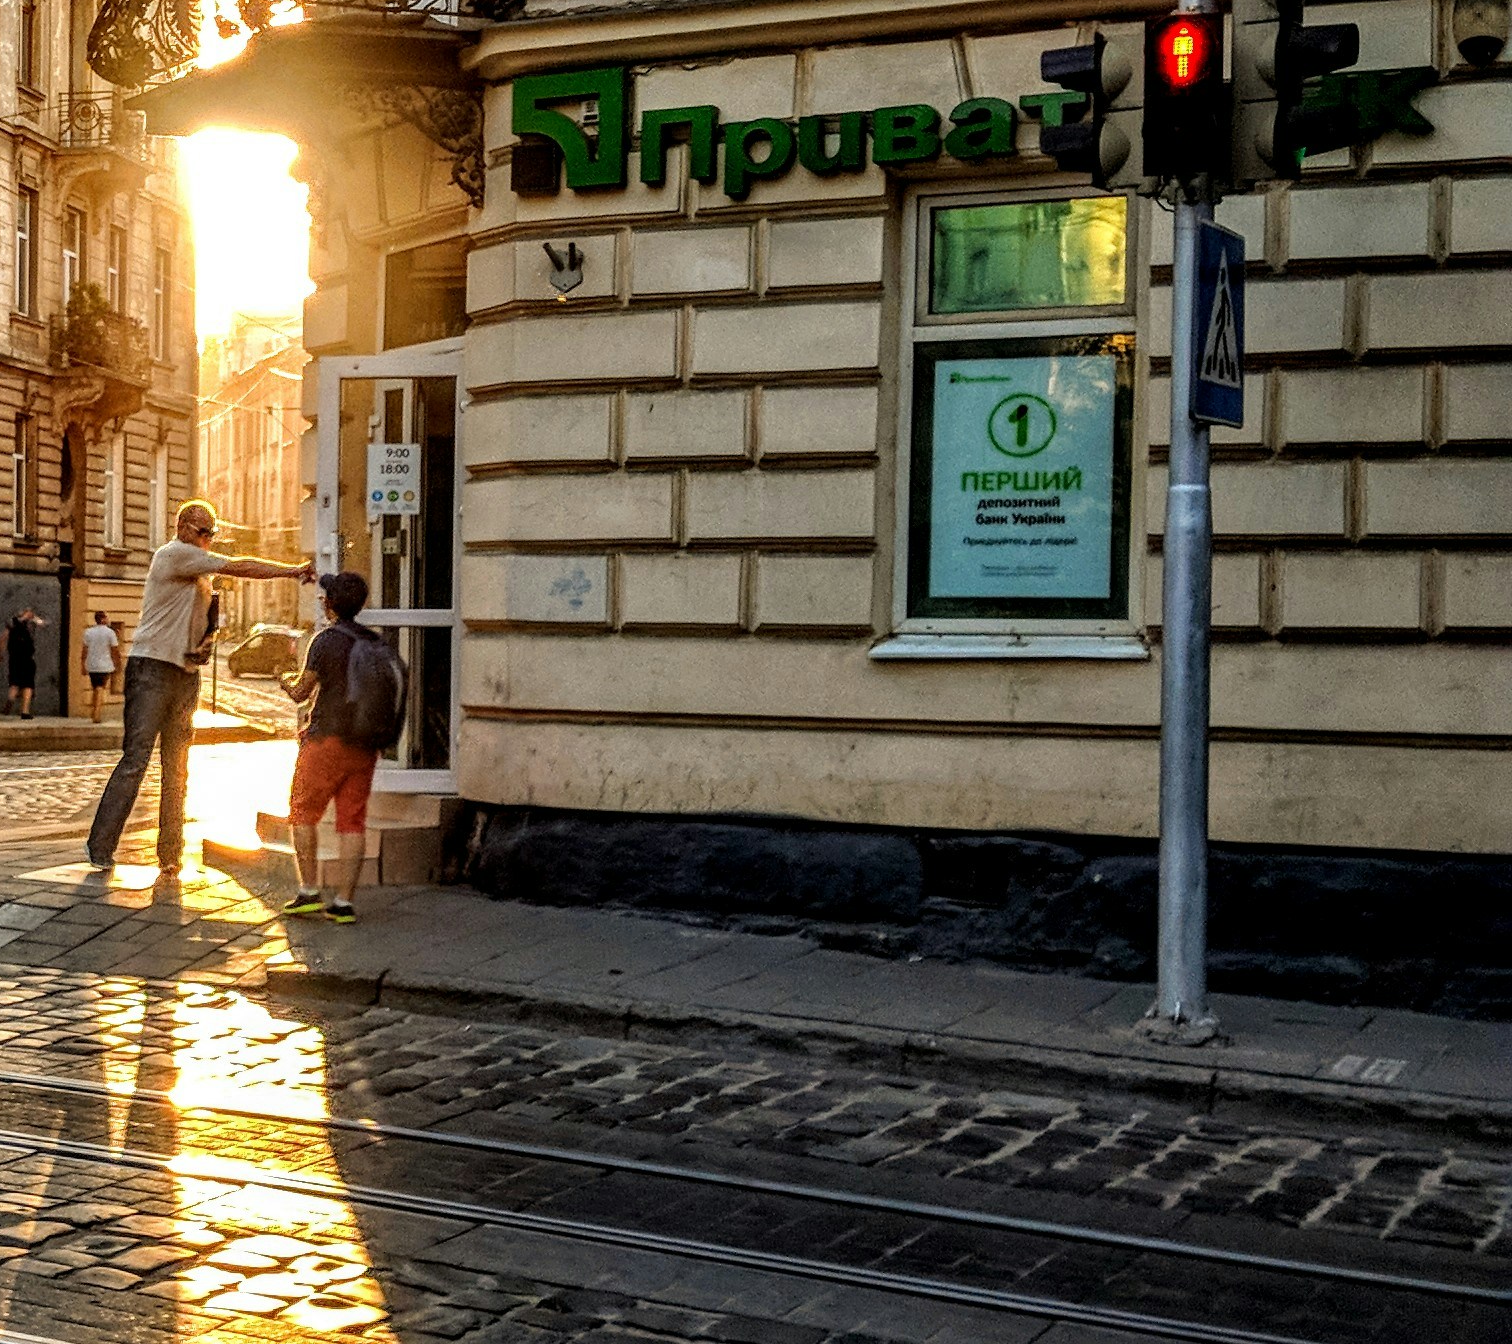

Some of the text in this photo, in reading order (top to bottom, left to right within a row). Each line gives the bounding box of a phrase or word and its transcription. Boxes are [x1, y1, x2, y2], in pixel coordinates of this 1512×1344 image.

[386, 448, 410, 458] 9:00
[380, 464, 410, 474] 18:00
[961, 466, 1083, 492] ПЕРШИЙ
[977, 495, 1061, 510] депозитний
[975, 512, 1066, 527] банк України
